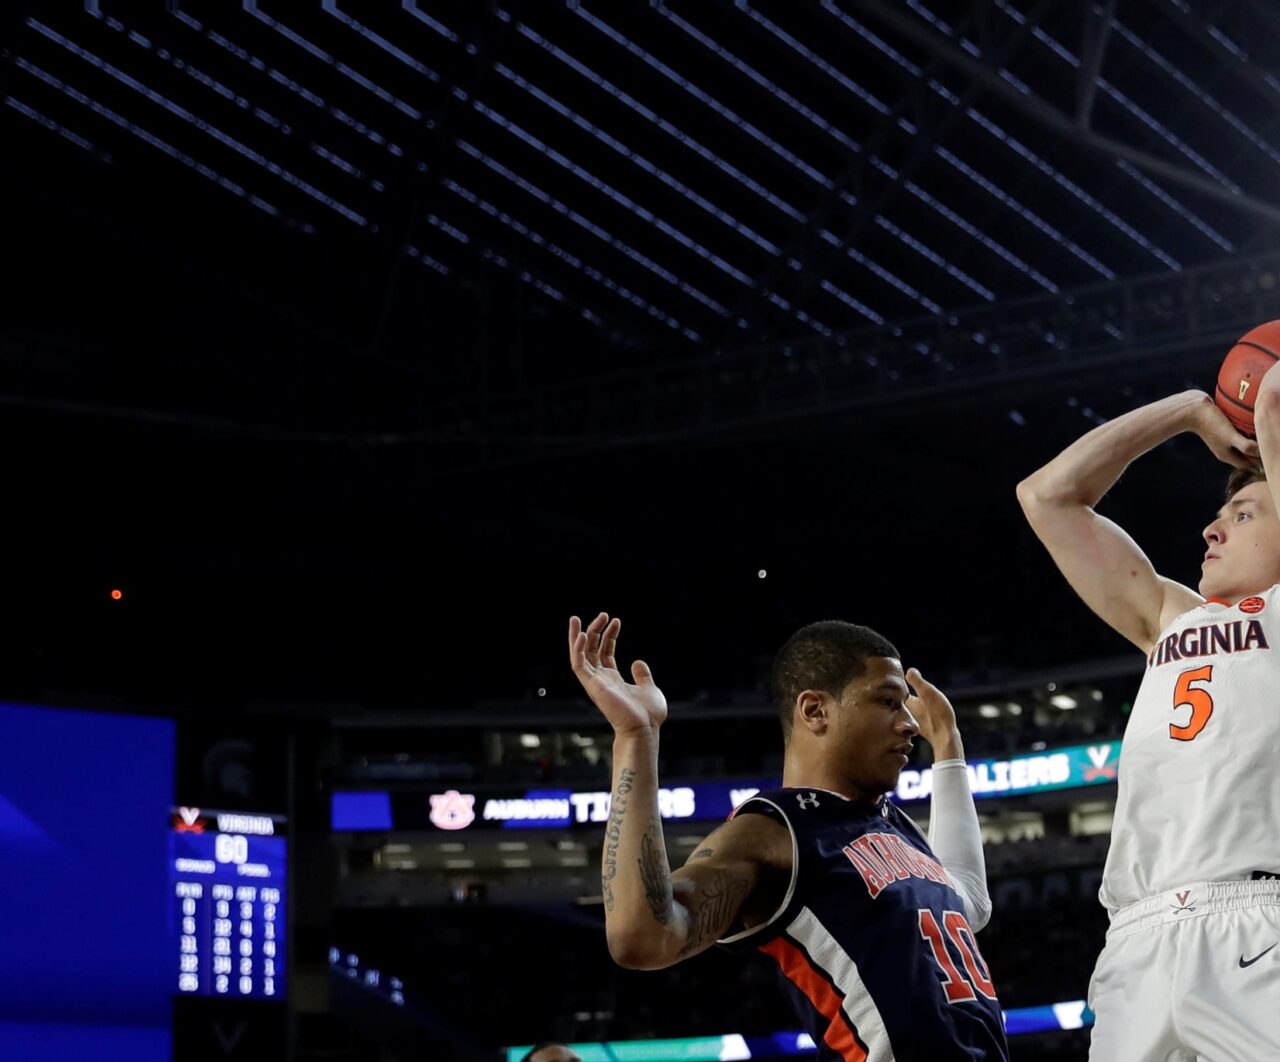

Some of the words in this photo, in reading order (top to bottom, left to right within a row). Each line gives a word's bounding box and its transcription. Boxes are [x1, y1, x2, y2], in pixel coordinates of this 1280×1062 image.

[1169, 664, 1214, 742] 5
[483, 798, 570, 820] AUBURN
[217, 813, 275, 836] VIRGINIA
[215, 833, 248, 864] 60
[263, 902, 276, 921] 2
[917, 908, 999, 1005] 10
